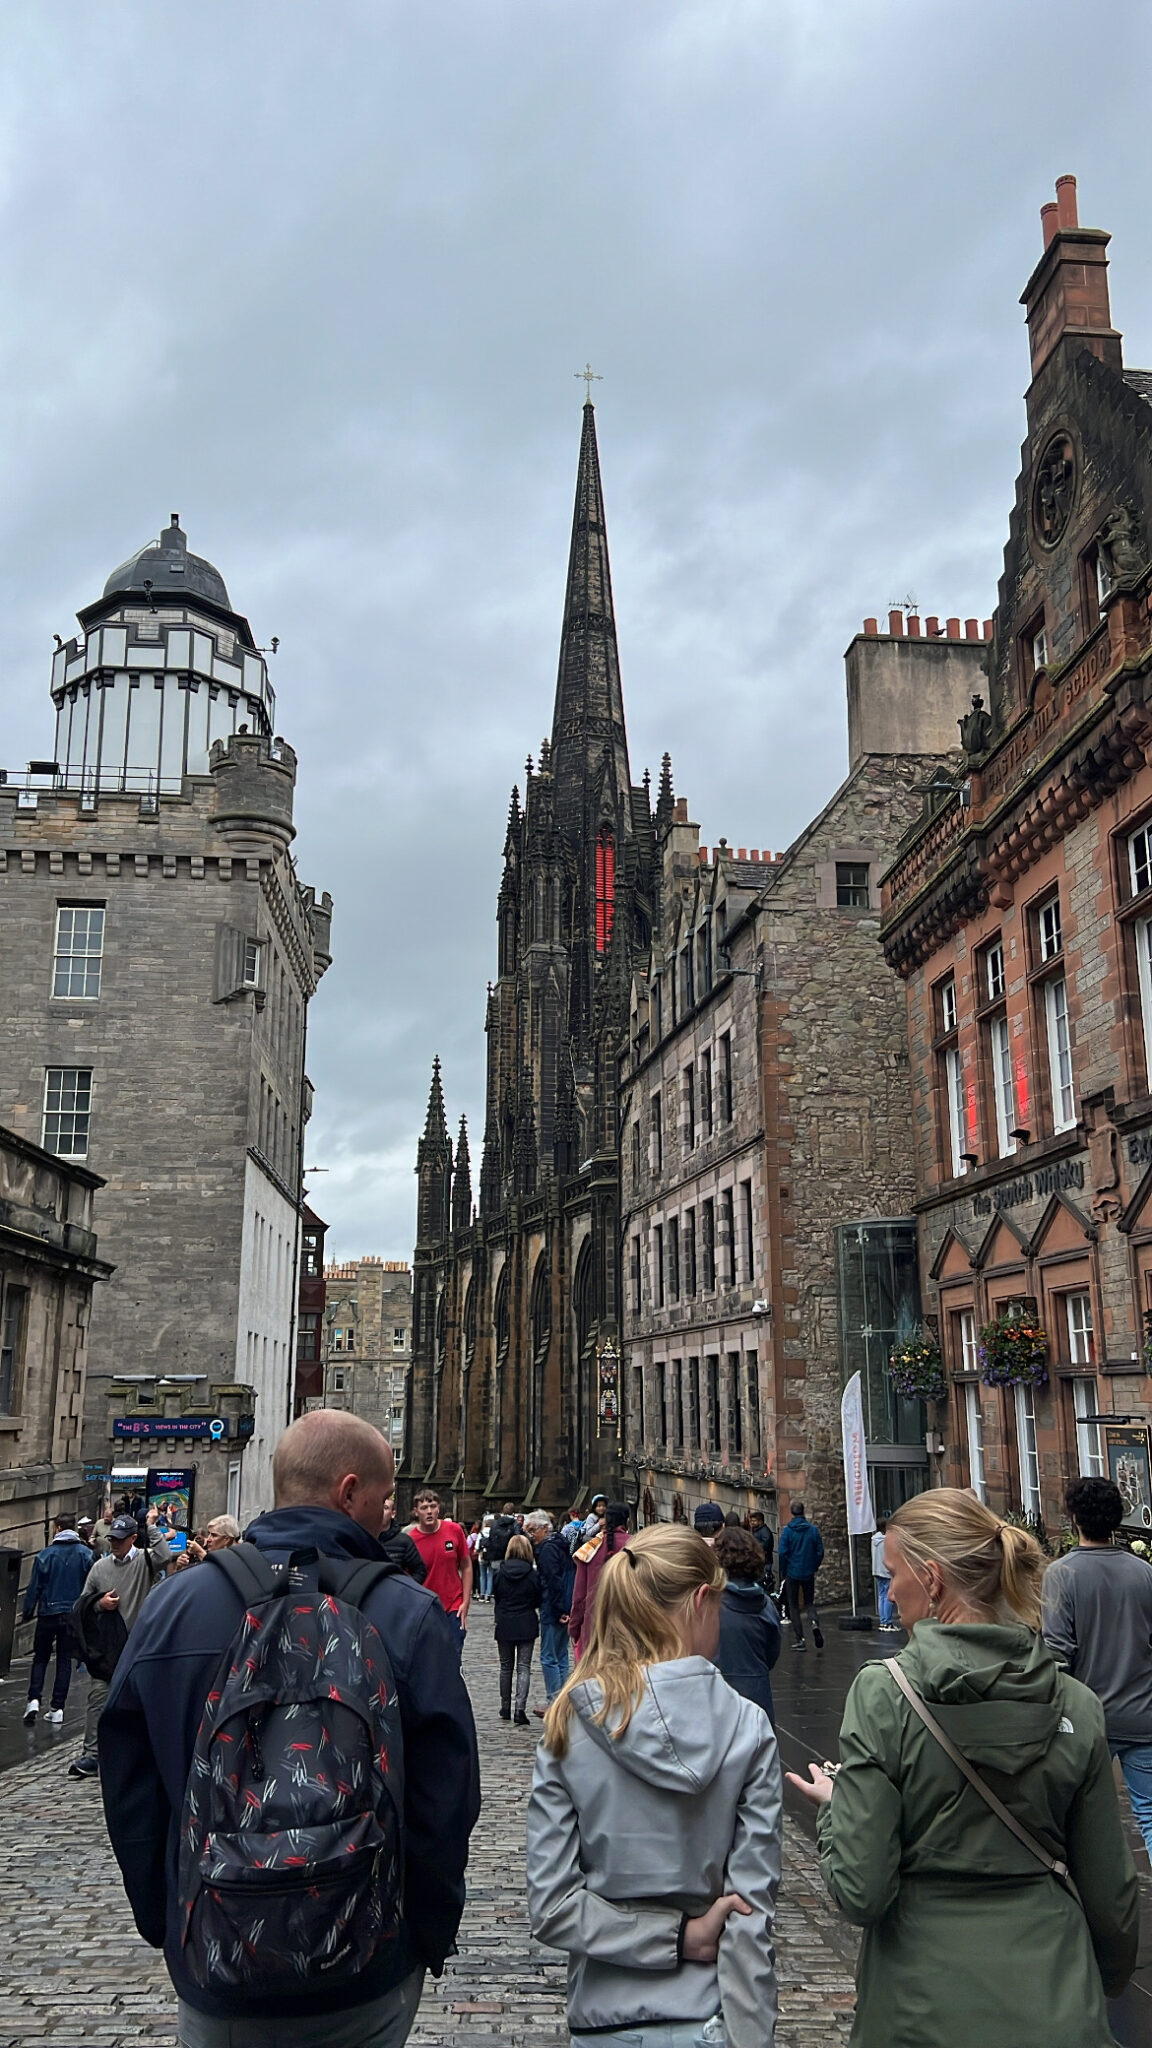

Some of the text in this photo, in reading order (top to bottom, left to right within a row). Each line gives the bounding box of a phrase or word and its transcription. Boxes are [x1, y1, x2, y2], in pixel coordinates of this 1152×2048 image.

[1035, 699, 1060, 741] HILL
[971, 1193, 991, 1217] The
[993, 1176, 1033, 1210] Scotch
[1034, 1159, 1084, 1196] Whisky
